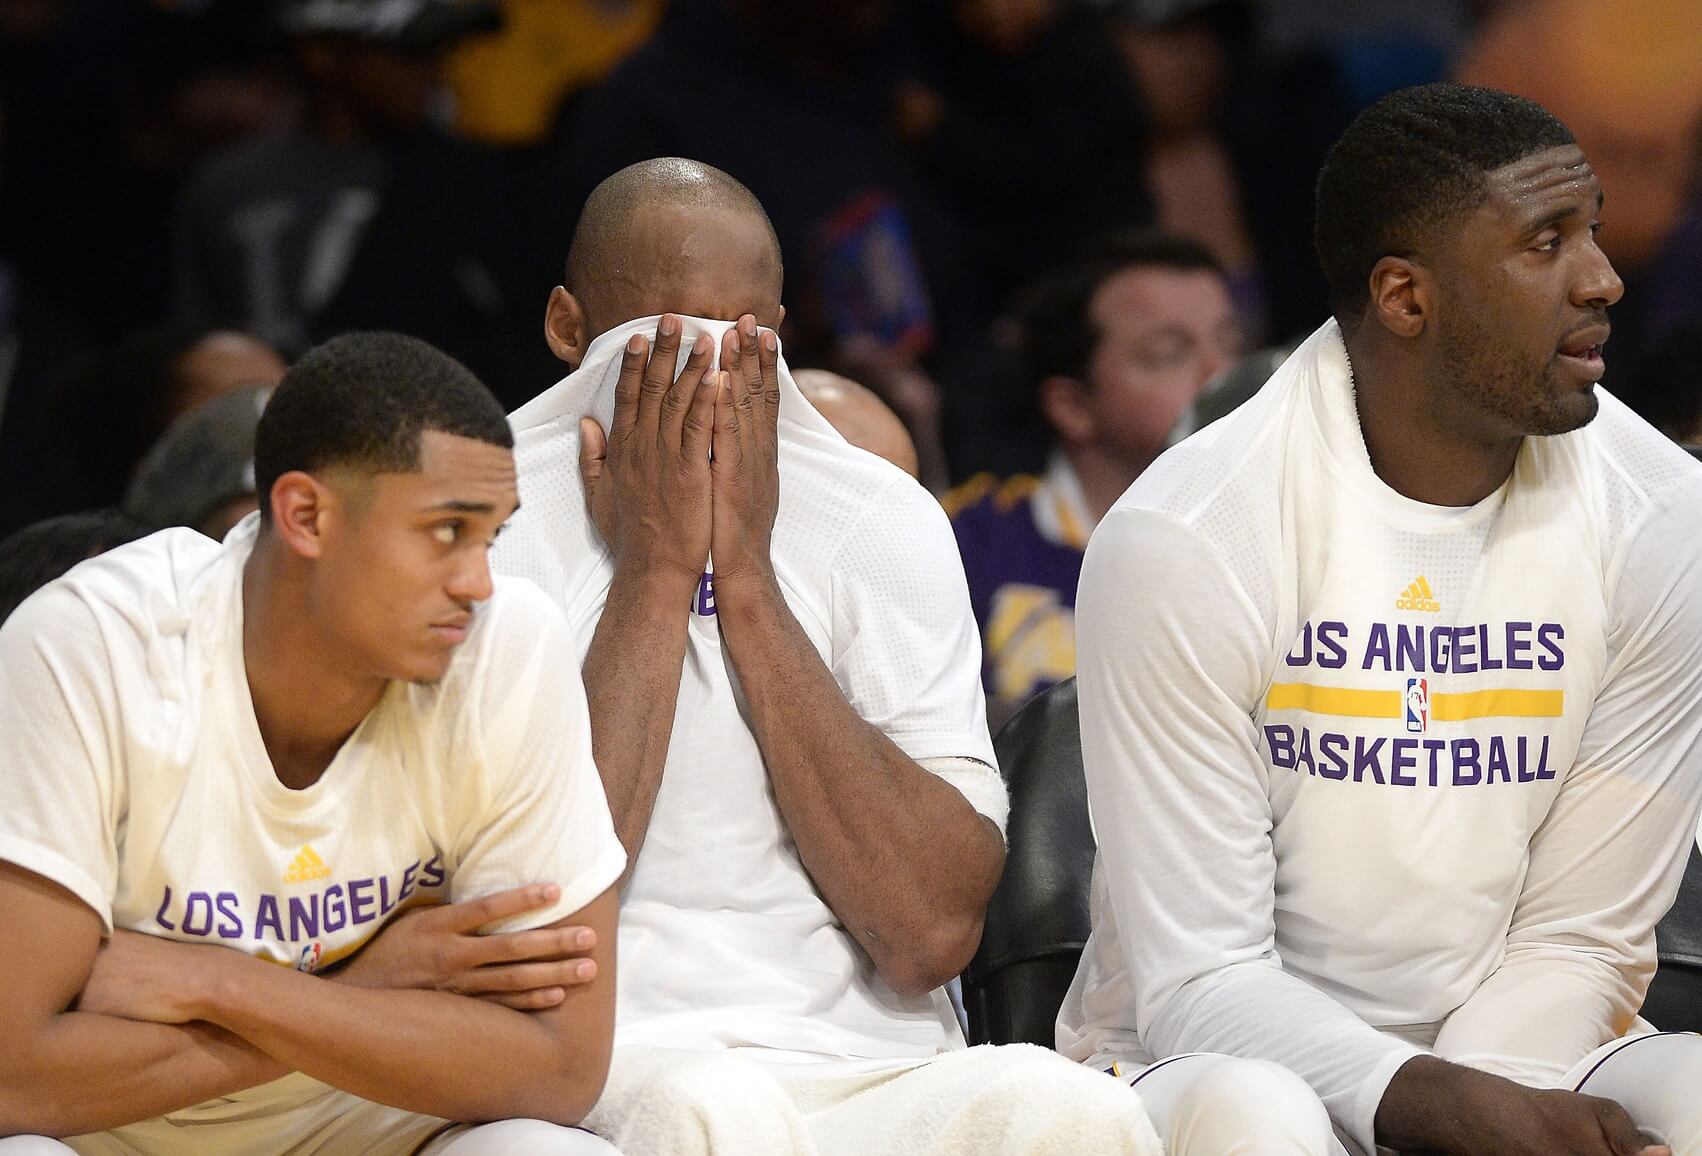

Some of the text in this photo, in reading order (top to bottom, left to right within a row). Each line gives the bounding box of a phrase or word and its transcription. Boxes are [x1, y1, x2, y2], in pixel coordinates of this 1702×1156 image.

[1396, 599, 1440, 612] adidas
[1286, 621, 1565, 673] OS ANGELES
[1264, 724, 1556, 787] BASKETBALL
[155, 851, 445, 941] LOS ANGELES
